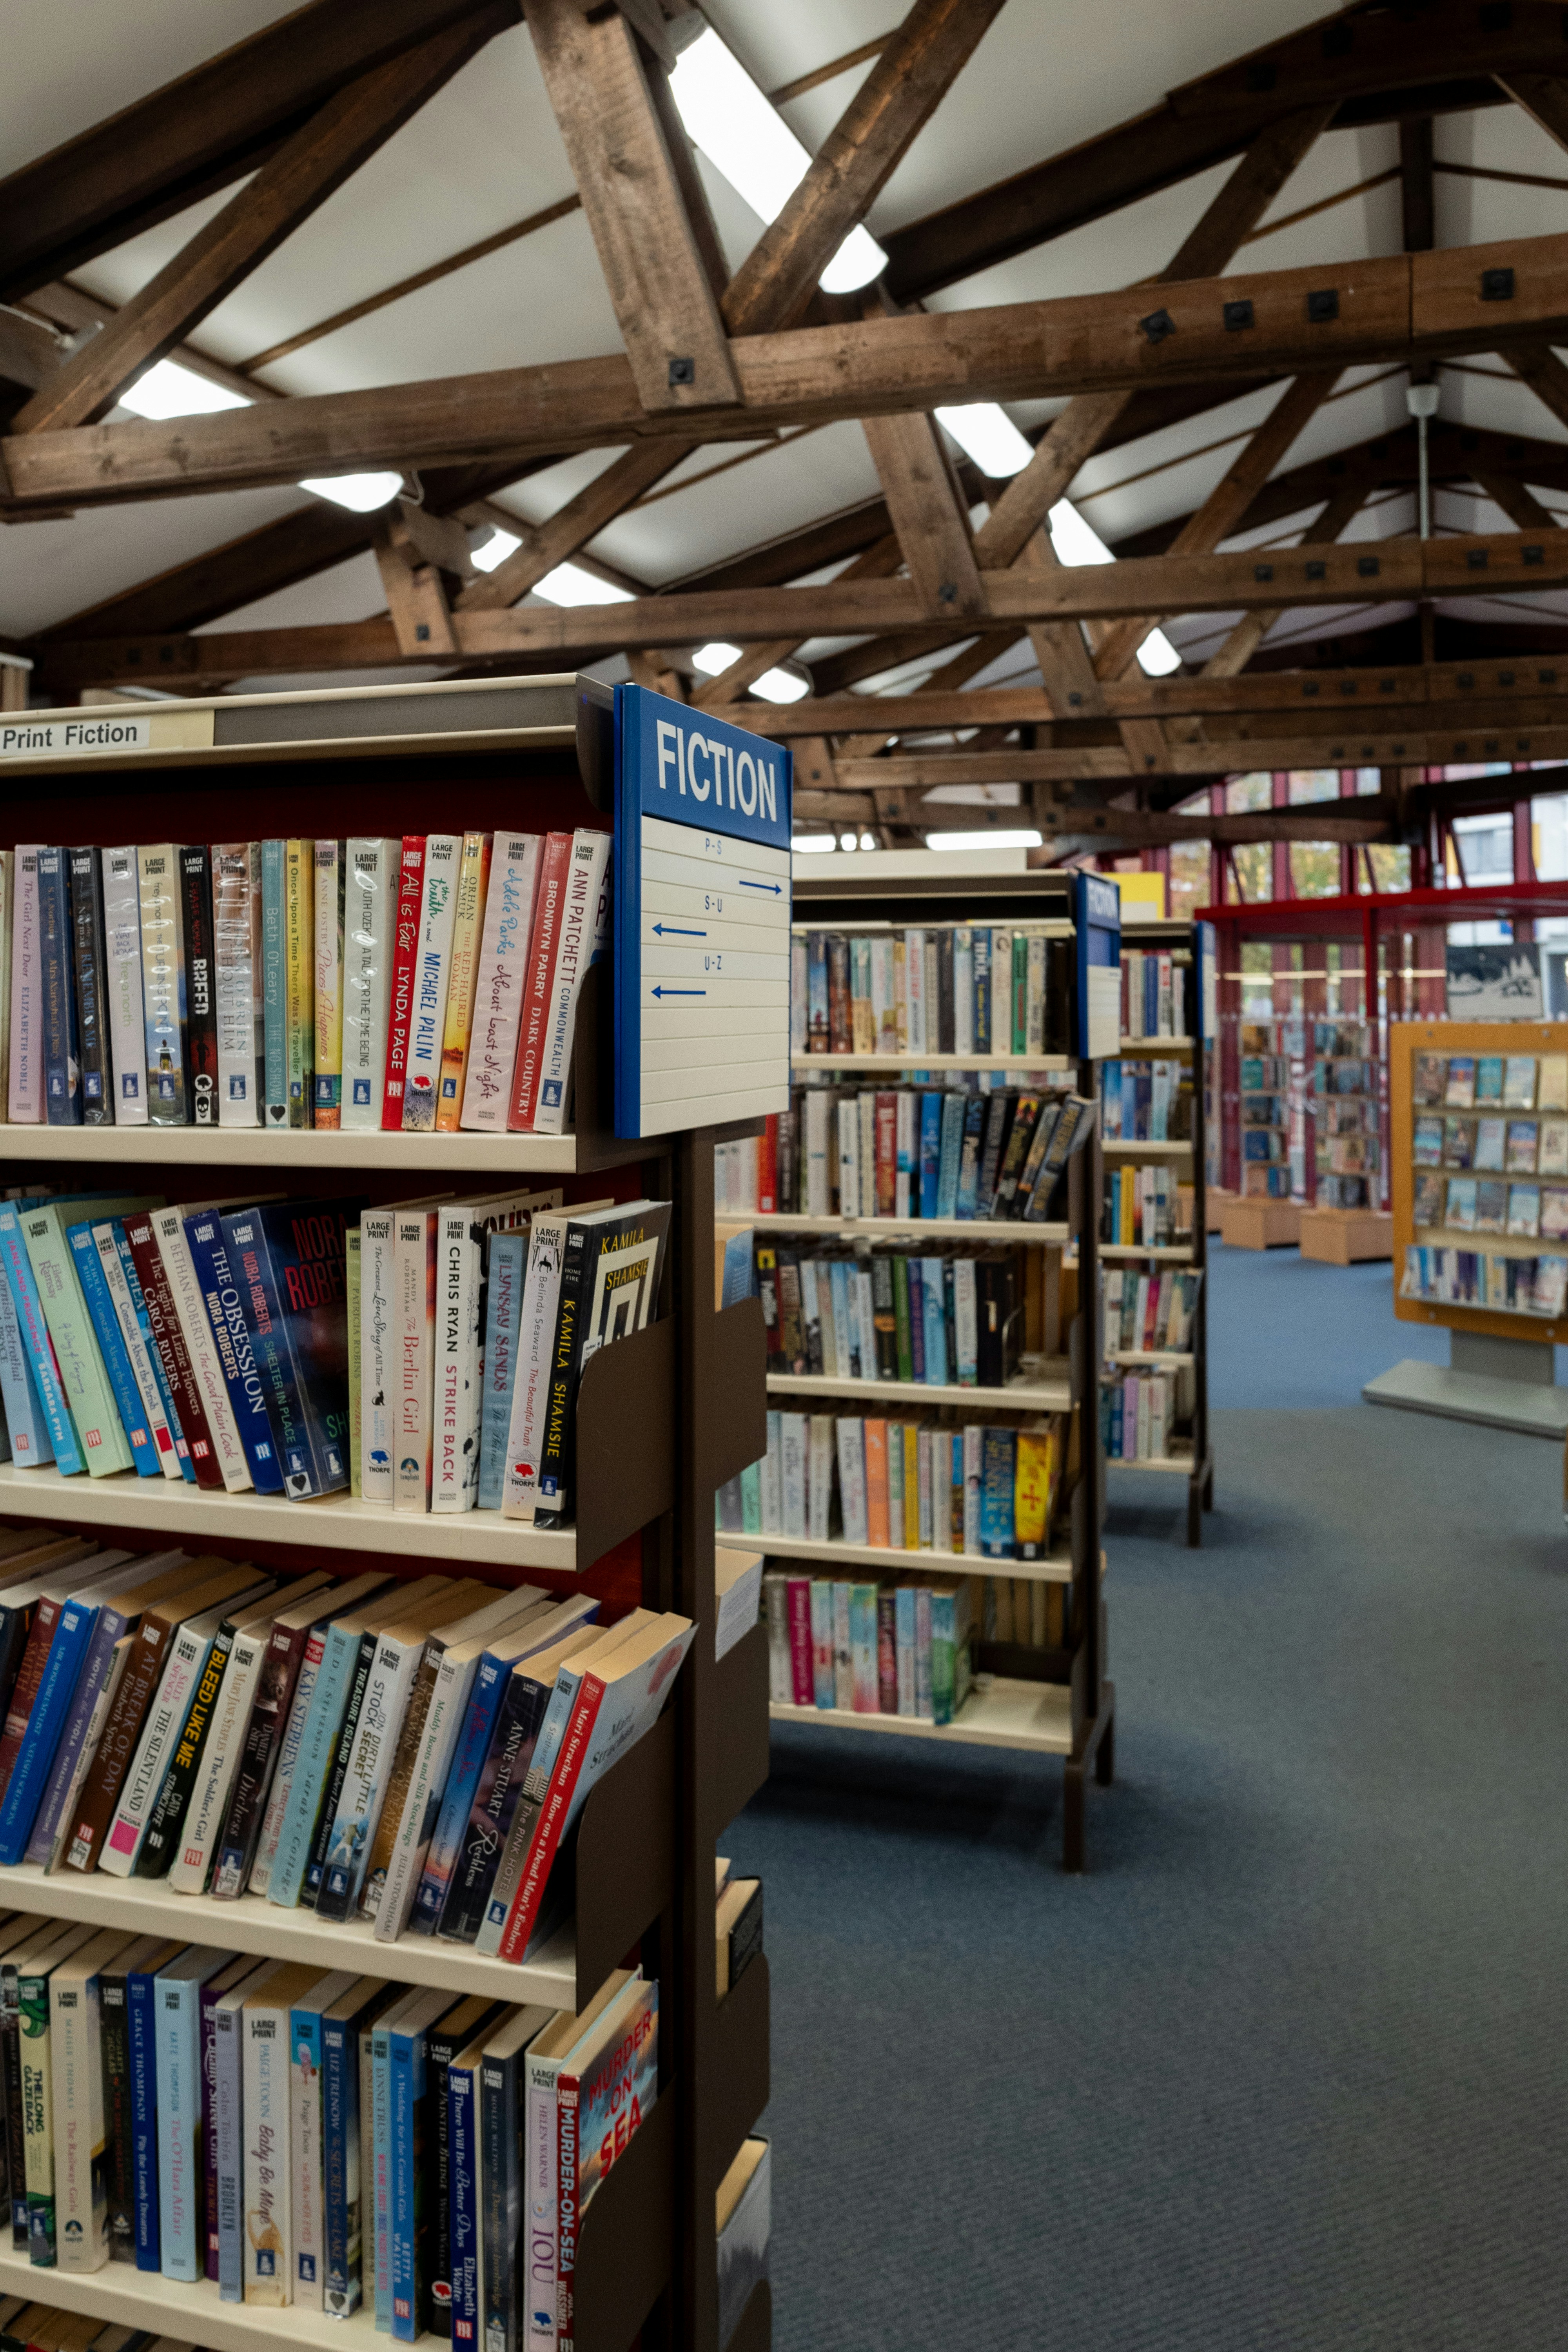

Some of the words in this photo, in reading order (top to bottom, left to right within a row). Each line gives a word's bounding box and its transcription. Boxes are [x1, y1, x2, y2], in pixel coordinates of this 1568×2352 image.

[3, 728, 52, 749] Print
[66, 723, 137, 745] Fiction
[656, 719, 777, 822] FICTION
[356, 854, 377, 862] LARGE
[403, 859, 421, 867] PRINT
[508, 852, 524, 860] PRINT
[509, 842, 525, 851] LARGE
[575, 853, 593, 861] PRINT
[576, 846, 594, 854] LARGE
[24, 882, 33, 898] The
[402, 872, 419, 897] All
[428, 878, 446, 920] truth
[441, 883, 450, 902] the
[457, 878, 468, 919] PAMUK
[466, 877, 477, 920] ORHAN
[502, 868, 522, 913] Adele
[570, 869, 588, 900] ANN
[24, 902, 32, 922] Girl
[267, 907, 278, 942] Beth
[401, 904, 416, 916] is
[541, 880, 558, 950] BRONWYN
[398, 921, 416, 952] Fair
[497, 917, 518, 955] Parks
[561, 905, 584, 984] PATCHETT
[22, 954, 31, 977] Door
[267, 951, 279, 1005] O'Leary
[420, 952, 441, 1010] MICHAEL
[450, 953, 461, 1001] WOMAN
[535, 955, 548, 999] PARRY
[395, 967, 410, 1021] LYNDA
[457, 951, 471, 1028] RED-HAIRED
[490, 965, 512, 1011] About
[20, 986, 29, 1051] ELIZABETH
[269, 1024, 281, 1041] THE
[415, 1016, 436, 1060] PALIN
[486, 1018, 507, 1050] Last
[528, 1007, 541, 1045] DARK
[550, 988, 571, 1076] COMMONWEALTH
[392, 1028, 406, 1069] PAGE
[20, 1055, 28, 1093] NOBLE
[270, 1049, 282, 1098] NO-SHOW
[476, 1055, 502, 1099] Night
[518, 1051, 535, 1117] COUNTRY
[367, 1222, 390, 1230] LARGE
[448, 1221, 463, 1230] LARGE
[601, 1227, 644, 1254] KAMILA
[150, 1254, 162, 1279] The
[212, 1247, 232, 1286] THE
[242, 1251, 260, 1284] NORA
[448, 1247, 460, 1299] CHRIS
[606, 1258, 649, 1290] SHAMSIE
[7, 1241, 20, 1266] JANE
[16, 1270, 27, 1292] AND
[23, 1296, 42, 1353] PRUDENCE
[156, 1281, 172, 1313] Fight
[171, 1243, 192, 1292] BETHAN
[185, 1296, 207, 1348] ROBERTS
[249, 1285, 272, 1335] ROBERTS
[497, 1265, 512, 1328] LYNSAY
[535, 1276, 547, 1313] Belinda
[144, 1288, 165, 1338] CAROL
[159, 1340, 181, 1391] RIVERS
[163, 1314, 178, 1330] for
[207, 1292, 224, 1324] NORA
[216, 1326, 239, 1380] ROBERTS
[447, 1308, 458, 1352] RYAN
[532, 1319, 543, 1362] Seaward
[557, 1300, 575, 1368] KAMILA
[171, 1333, 187, 1368] Lizzie
[221, 1288, 266, 1413] OBSESSION
[265, 1341, 283, 1390] SHELTER
[404, 1336, 419, 1390] Berlin
[494, 1335, 508, 1391] SANDS
[182, 1371, 200, 1415] Flowers
[530, 1369, 538, 1383] The
[39, 1363, 57, 1414] BARBARA
[53, 1418, 63, 1441] PYM
[276, 1392, 287, 1405] IN
[403, 1398, 419, 1433] Girl
[445, 1366, 457, 1427] STRIKE
[524, 1387, 537, 1423] Beautiful
[279, 1407, 296, 1444] PLACE
[523, 1426, 533, 1446] Truth
[547, 1383, 566, 1457] SHAMSIE
[443, 1435, 455, 1482] BACK
[143, 1651, 156, 1676] AT
[198, 1649, 226, 1704] BLEED
[299, 1669, 314, 1700] KAY
[347, 1666, 368, 1724] TREASURE
[365, 1680, 385, 1728] STOCK
[122, 1678, 149, 1732] BREAK
[153, 1710, 172, 1736] THE
[185, 1703, 208, 1742] LIKE
[576, 1706, 590, 1735] Mari
[114, 1735, 130, 1759] OF
[140, 1735, 162, 1779] SILENT
[176, 1740, 196, 1768] ME
[281, 1705, 307, 1777] STEPHENS
[339, 1724, 355, 1764] ISLAND
[354, 1730, 372, 1779] SECRET
[367, 1734, 381, 1774] DIRTY
[503, 1720, 523, 1762] ANNE
[558, 1735, 580, 1786] Strachan
[102, 1760, 122, 1796] DAY
[211, 1756, 224, 1776] The
[129, 1778, 149, 1811] LAND
[199, 1777, 219, 1819] Soldier's
[230, 1773, 256, 1837] Duchess
[355, 1773, 372, 1815] LITTLE
[487, 1765, 512, 1818] STUART
[194, 1818, 207, 1842] Girl
[521, 1804, 532, 1824] The
[466, 1824, 498, 1887] Reckless
[511, 1827, 526, 1855] PINK
[499, 1858, 516, 1895] HOTEL
[532, 2069, 556, 2079] LARGE
[589, 2009, 652, 2111] MURDER
[24, 2065, 33, 2100] GAZE
[533, 2078, 555, 2089] PRINT
[25, 2101, 34, 2135] BACK
[455, 2094, 464, 2127] There
[539, 2105, 547, 2141] HELEN
[251, 2124, 275, 2161] Baby
[456, 2129, 465, 2150] Will
[600, 2094, 642, 2179] SEA
[258, 2165, 274, 2185] Be
[456, 2151, 465, 2166] Be
[539, 2143, 548, 2189] WARNER
[221, 2176, 235, 2231] BROOKLYN
[258, 2187, 274, 2225] Mine
[456, 2169, 470, 2211] Better
[560, 2109, 575, 2273] MURDER-ON-SEA
[456, 2213, 471, 2248] Days
[532, 2227, 554, 2285] IOU
[453, 2267, 464, 2303] Waite
[464, 2257, 476, 2316] Elizabeth
